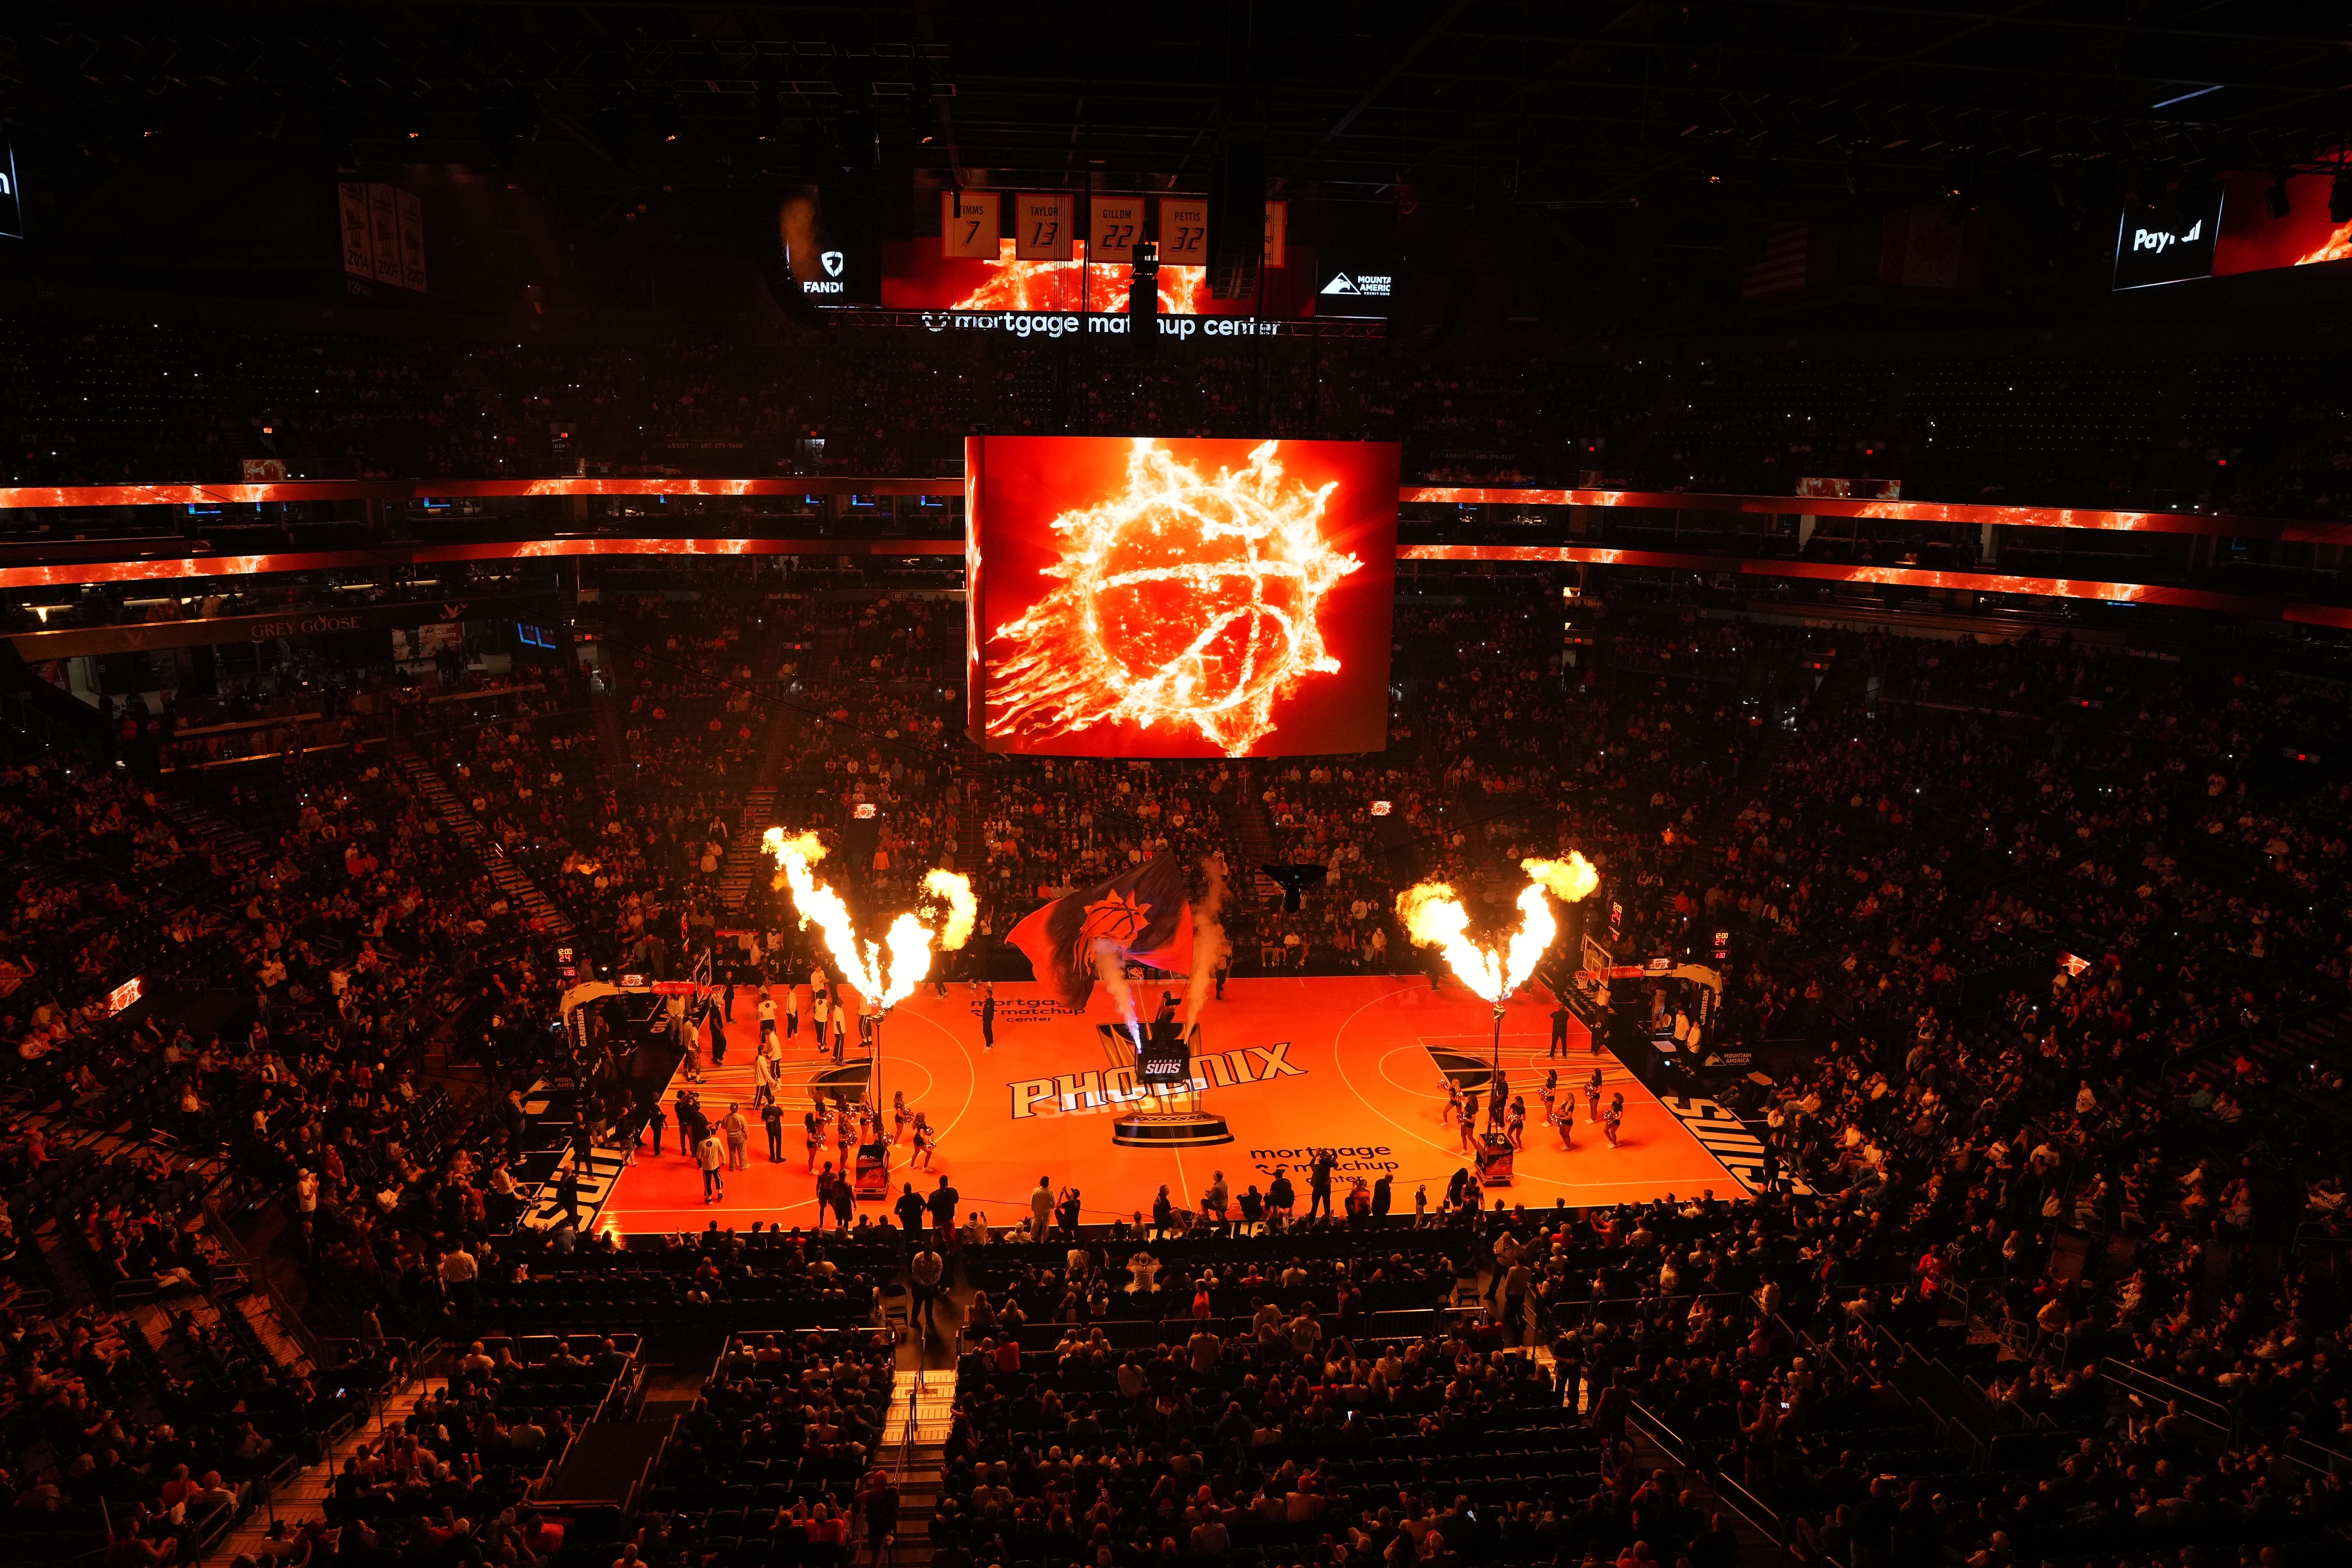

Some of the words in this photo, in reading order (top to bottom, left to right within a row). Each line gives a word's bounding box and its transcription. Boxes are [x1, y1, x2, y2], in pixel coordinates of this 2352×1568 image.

[1030, 206, 1058, 216] TAYLOR
[1102, 209, 1131, 220] GILLOM
[1175, 212, 1200, 221] PETTIS
[962, 221, 980, 246] 7
[1030, 221, 1058, 247] 13
[1099, 225, 1133, 250] 22
[1170, 227, 1204, 252] 32
[348, 249, 369, 270] 2014
[378, 259, 399, 278] 2009
[406, 267, 425, 284] 2007
[955, 311, 1079, 338] mortgage
[1088, 316, 1196, 340] matup
[1203, 316, 1281, 336] center
[251, 622, 294, 637] GREY
[300, 616, 360, 633] GOOSE
[2131, 649, 2146, 657] Bell
[2159, 653, 2180, 662] Bank
[1613, 901, 1622, 914] 12:00
[1611, 908, 1621, 926] 24
[559, 955, 571, 963] 24
[971, 999, 1067, 1008] mortga
[1294, 1160, 1399, 1172] mchup
[1305, 1175, 1363, 1183] cnter
